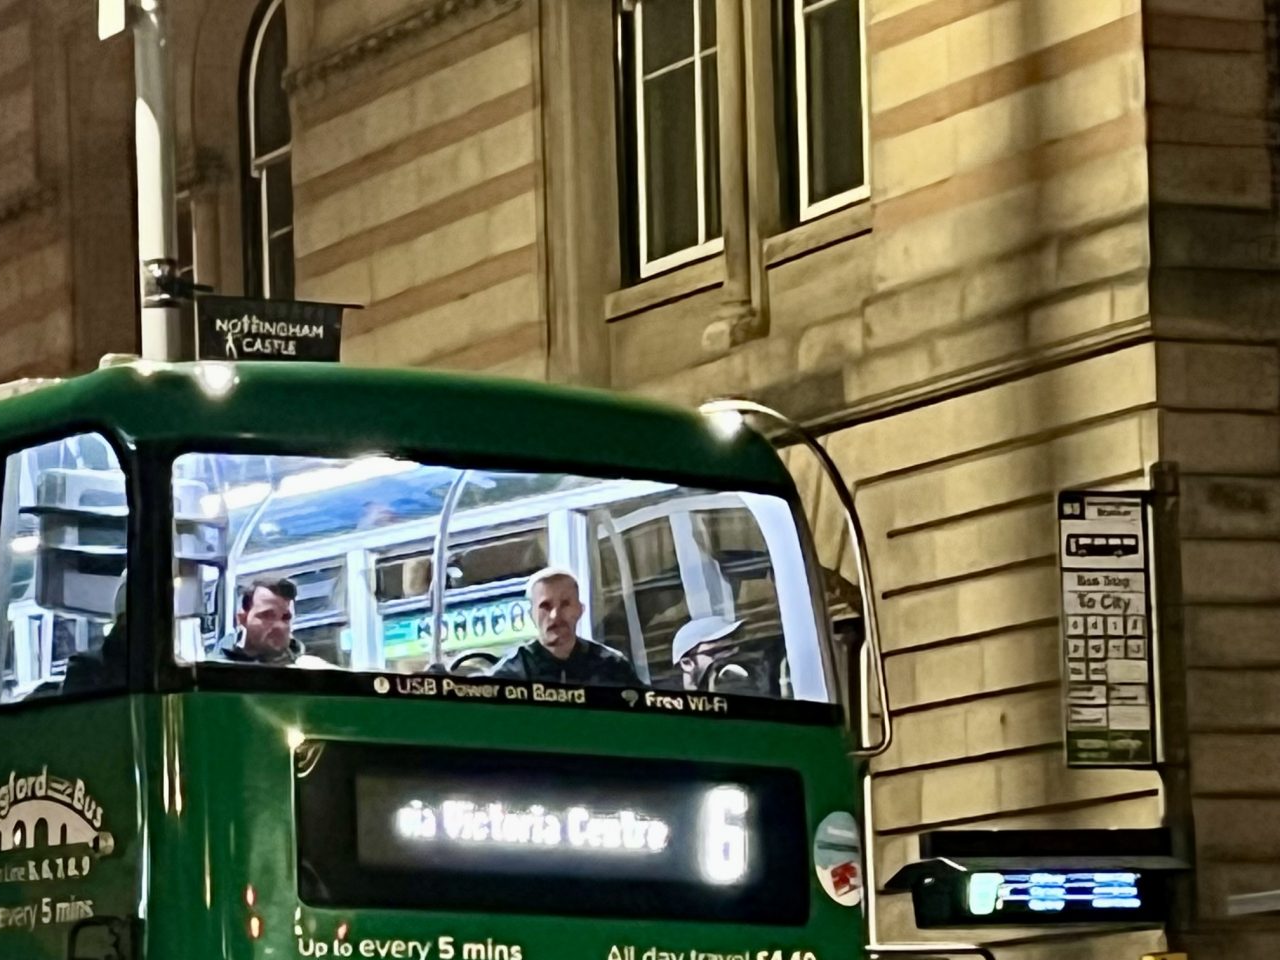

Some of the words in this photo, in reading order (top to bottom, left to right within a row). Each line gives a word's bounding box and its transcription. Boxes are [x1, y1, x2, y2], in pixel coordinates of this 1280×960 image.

[215, 314, 324, 338] NOTTINGHAM
[242, 338, 297, 355] CASTLE
[1078, 593, 1096, 609] To
[1101, 593, 1131, 613] City
[396, 677, 437, 696] USB
[443, 678, 499, 699] Power
[505, 685, 528, 700] on
[533, 683, 585, 703] Board
[645, 691, 684, 710] Free
[73, 777, 104, 828] Bus
[443, 798, 560, 846] Victoria
[567, 805, 669, 853] Centre
[700, 786, 748, 886] 6
[41, 897, 52, 924] 5
[55, 895, 94, 923] mins
[297, 937, 328, 960] Up
[332, 938, 354, 957] to
[438, 936, 453, 960] 5
